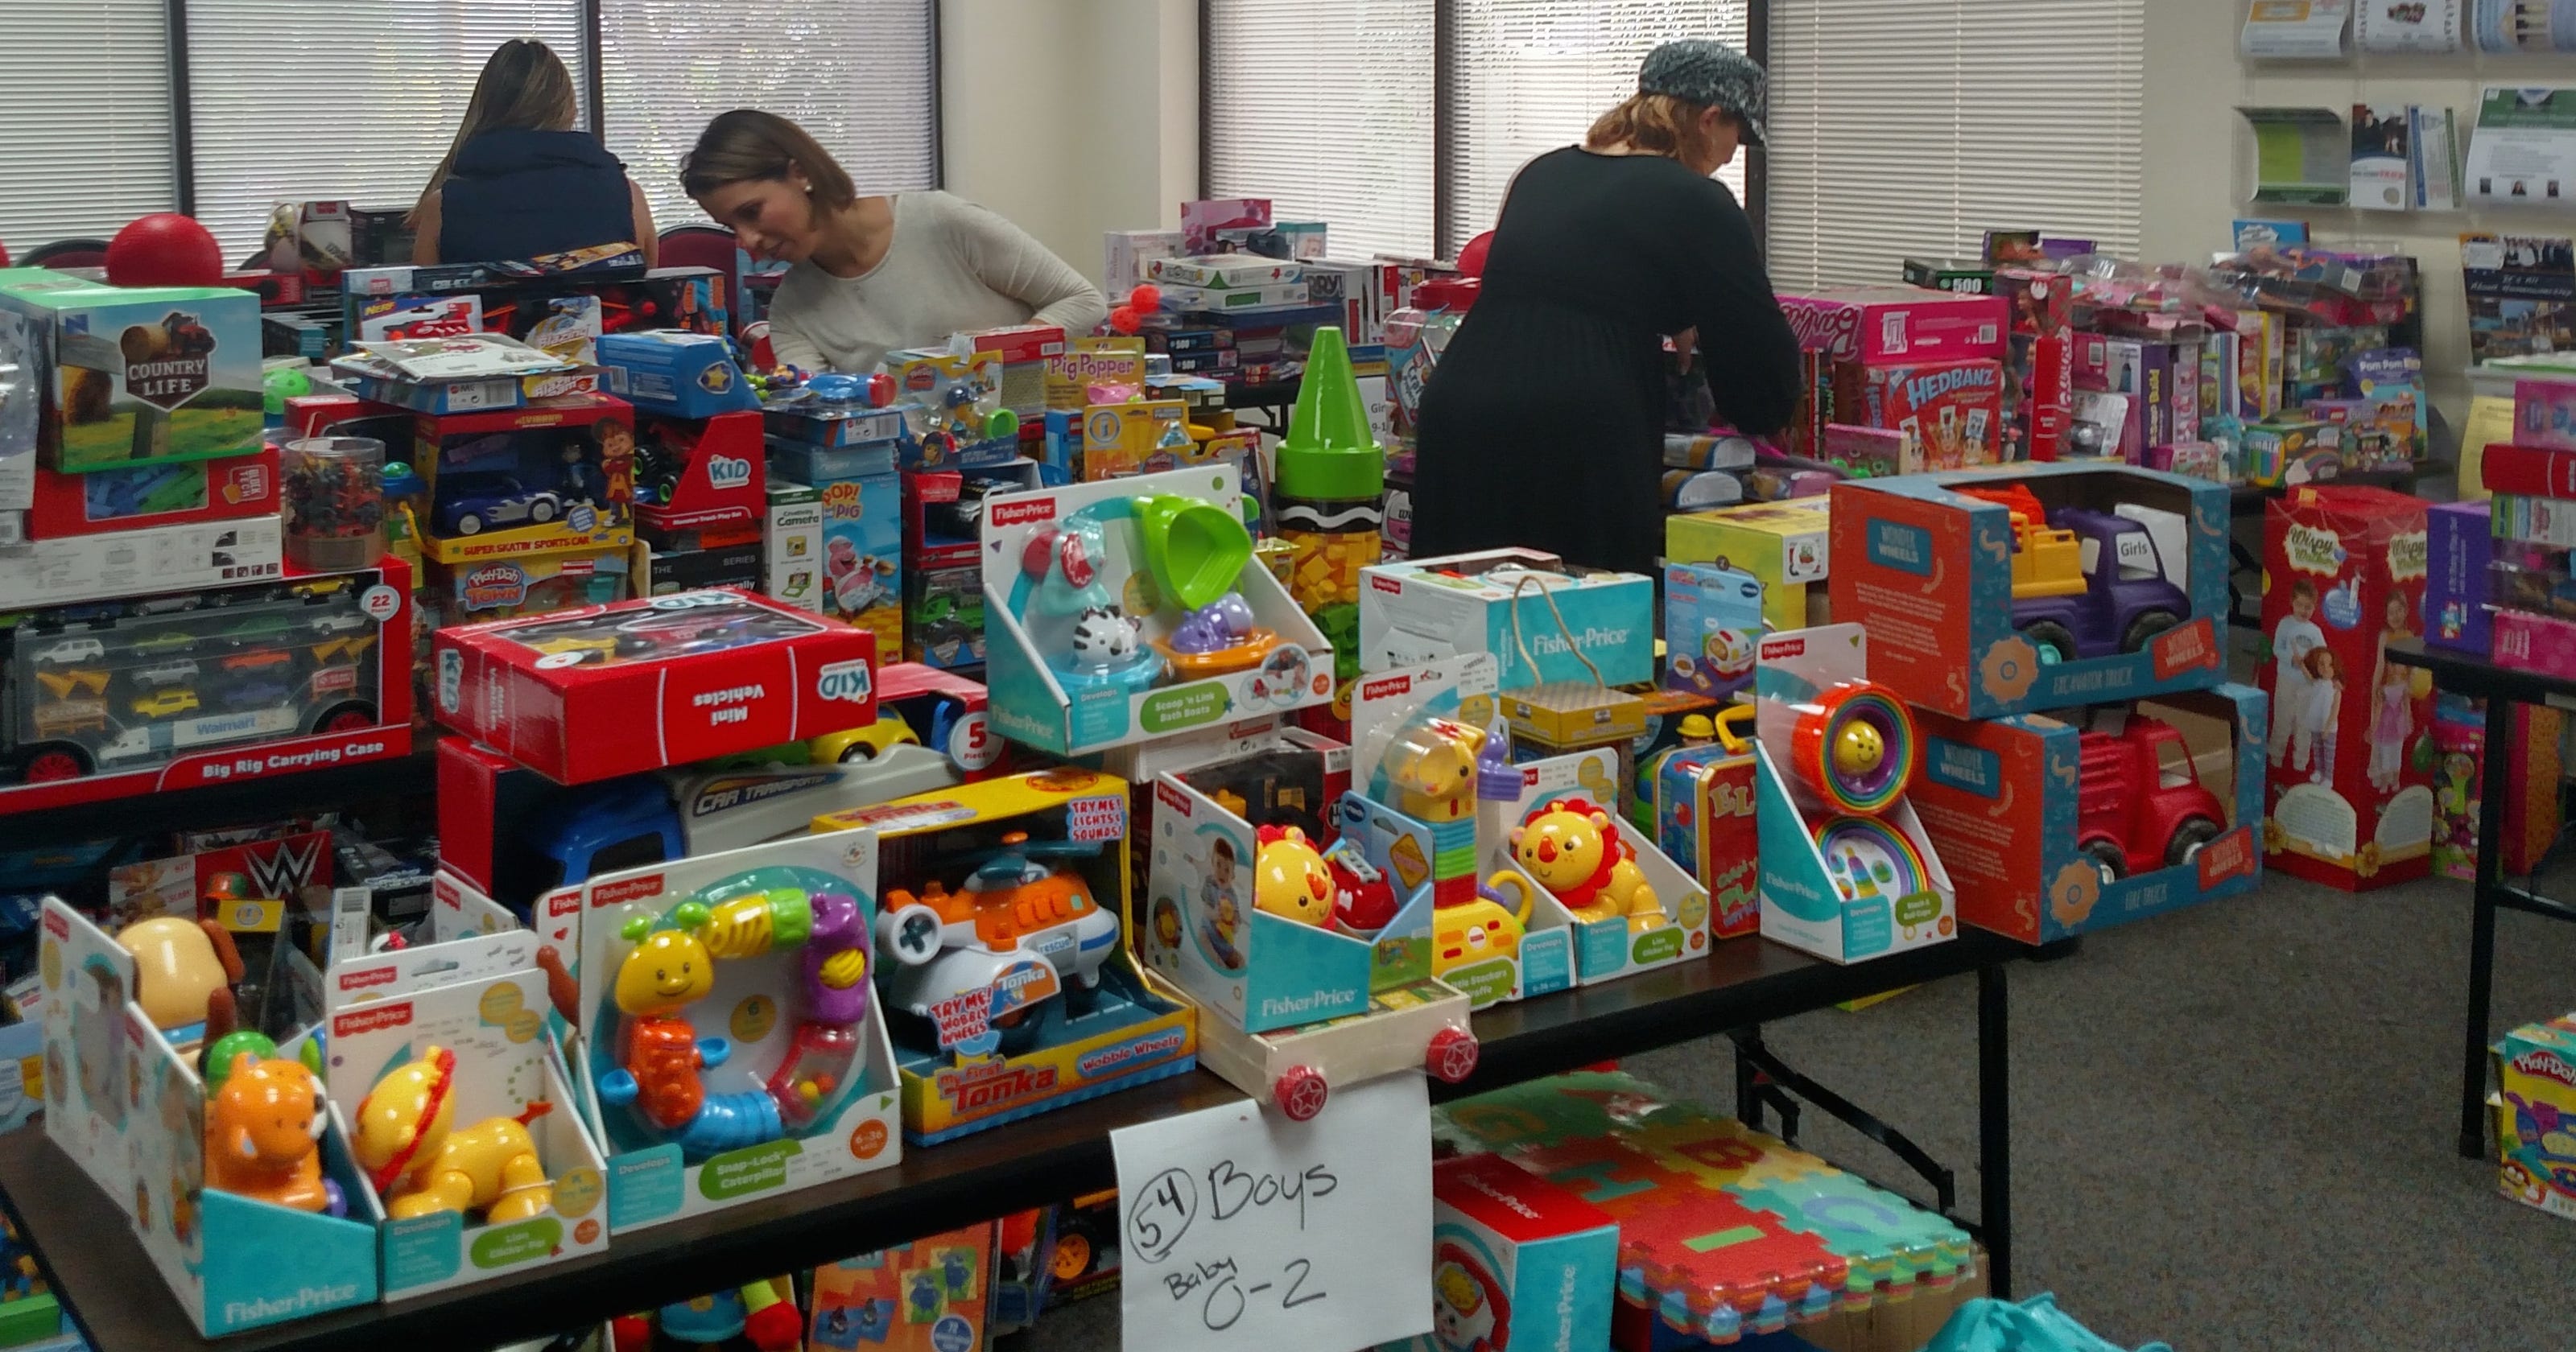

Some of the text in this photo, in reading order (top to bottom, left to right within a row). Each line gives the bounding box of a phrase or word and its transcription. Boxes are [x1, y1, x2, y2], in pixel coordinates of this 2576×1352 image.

[1953, 278, 1981, 293] 500
[365, 301, 395, 315] NERF
[128, 359, 205, 381] COUNTRY
[1050, 352, 1135, 381] Pig Popper
[143, 377, 192, 396] LIFE
[1905, 368, 1995, 411] HEDBANZ
[711, 461, 749, 481] KID
[823, 483, 861, 505] POP!
[777, 515, 819, 528] Camera
[995, 505, 1052, 522] Fisher-Price
[464, 543, 496, 555] SUPER
[534, 538, 571, 550] SPORTS
[572, 536, 590, 546] CAR
[2120, 542, 2148, 557] Girls
[2290, 528, 2334, 554] Wispy
[724, 555, 756, 567] SERIES
[1878, 542, 1919, 563] WHEELS
[469, 567, 520, 586] Play-Doh
[654, 566, 673, 575] THE
[371, 595, 391, 608] 22
[465, 587, 521, 605] TOWN
[1532, 627, 1629, 656] Fisher-Price
[1763, 642, 1802, 657] Fisher-Price
[693, 683, 765, 707] Vehicles
[821, 670, 869, 699] KID
[1080, 687, 1118, 702] Develops
[1366, 680, 1408, 695] Fisher-Price
[1154, 699, 1183, 715] Scoop
[1195, 691, 1216, 704] Link
[1160, 704, 1212, 723] Bath Boats
[711, 706, 749, 726] Mini
[969, 722, 986, 748] 5
[202, 741, 384, 778] Big Rig Carrying Case
[1940, 762, 1987, 786] WHEELS
[696, 789, 741, 817] CAR
[1071, 798, 1122, 814] TRY ME!
[1708, 776, 1757, 818] EL
[1073, 814, 1114, 826] LIGHTS
[1072, 826, 1121, 842] SOUNDS!
[595, 880, 660, 901] Fisher-Price
[1039, 938, 1071, 954] rescue
[1526, 937, 1563, 952] Develops
[997, 967, 1046, 991] Tonka
[931, 986, 993, 1019] TRY ME!
[1261, 988, 1356, 1019] Fisher-Price
[339, 1007, 407, 1029] Fisher-Price
[939, 1008, 989, 1032] WOBBLY
[941, 1023, 988, 1045] WHEELS
[1082, 1035, 1180, 1072] Wobble Wheels
[944, 1068, 1055, 1111] Tonka
[618, 1156, 671, 1175] Develops
[716, 1150, 786, 1175] Snap-Lock
[720, 1167, 786, 1189] Caterpillar
[1208, 1160, 1338, 1230] Boys
[1163, 1257, 1238, 1301] Baby
[225, 1284, 357, 1325] Fisher-Price
